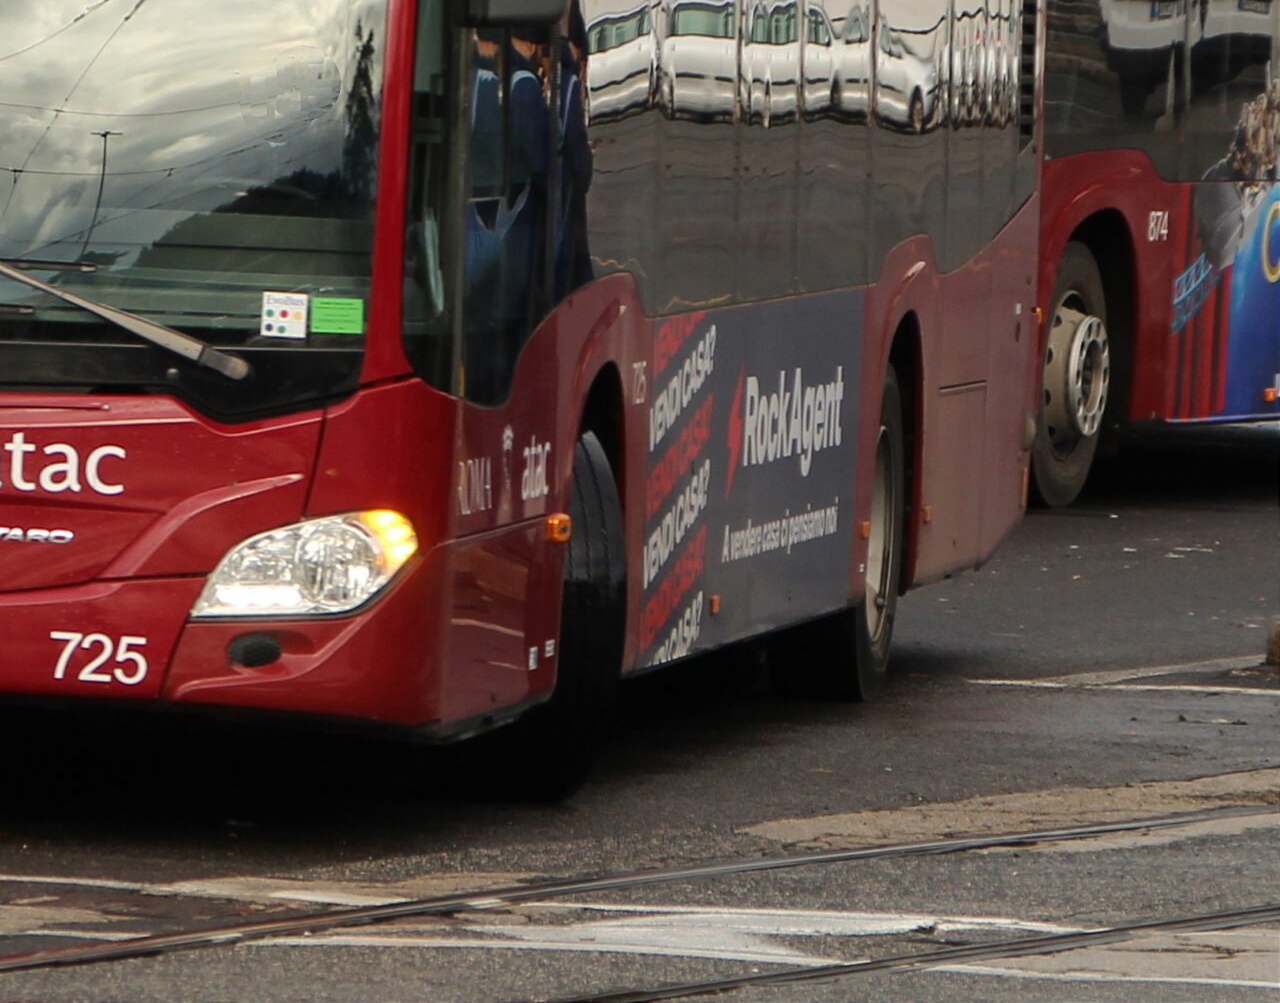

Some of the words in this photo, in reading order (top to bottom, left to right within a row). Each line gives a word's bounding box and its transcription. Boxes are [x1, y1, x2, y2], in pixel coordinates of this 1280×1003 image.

[1148, 211, 1169, 242] 874
[743, 365, 844, 477] RockAgent
[721, 524, 730, 564] A
[50, 630, 148, 686] 725
